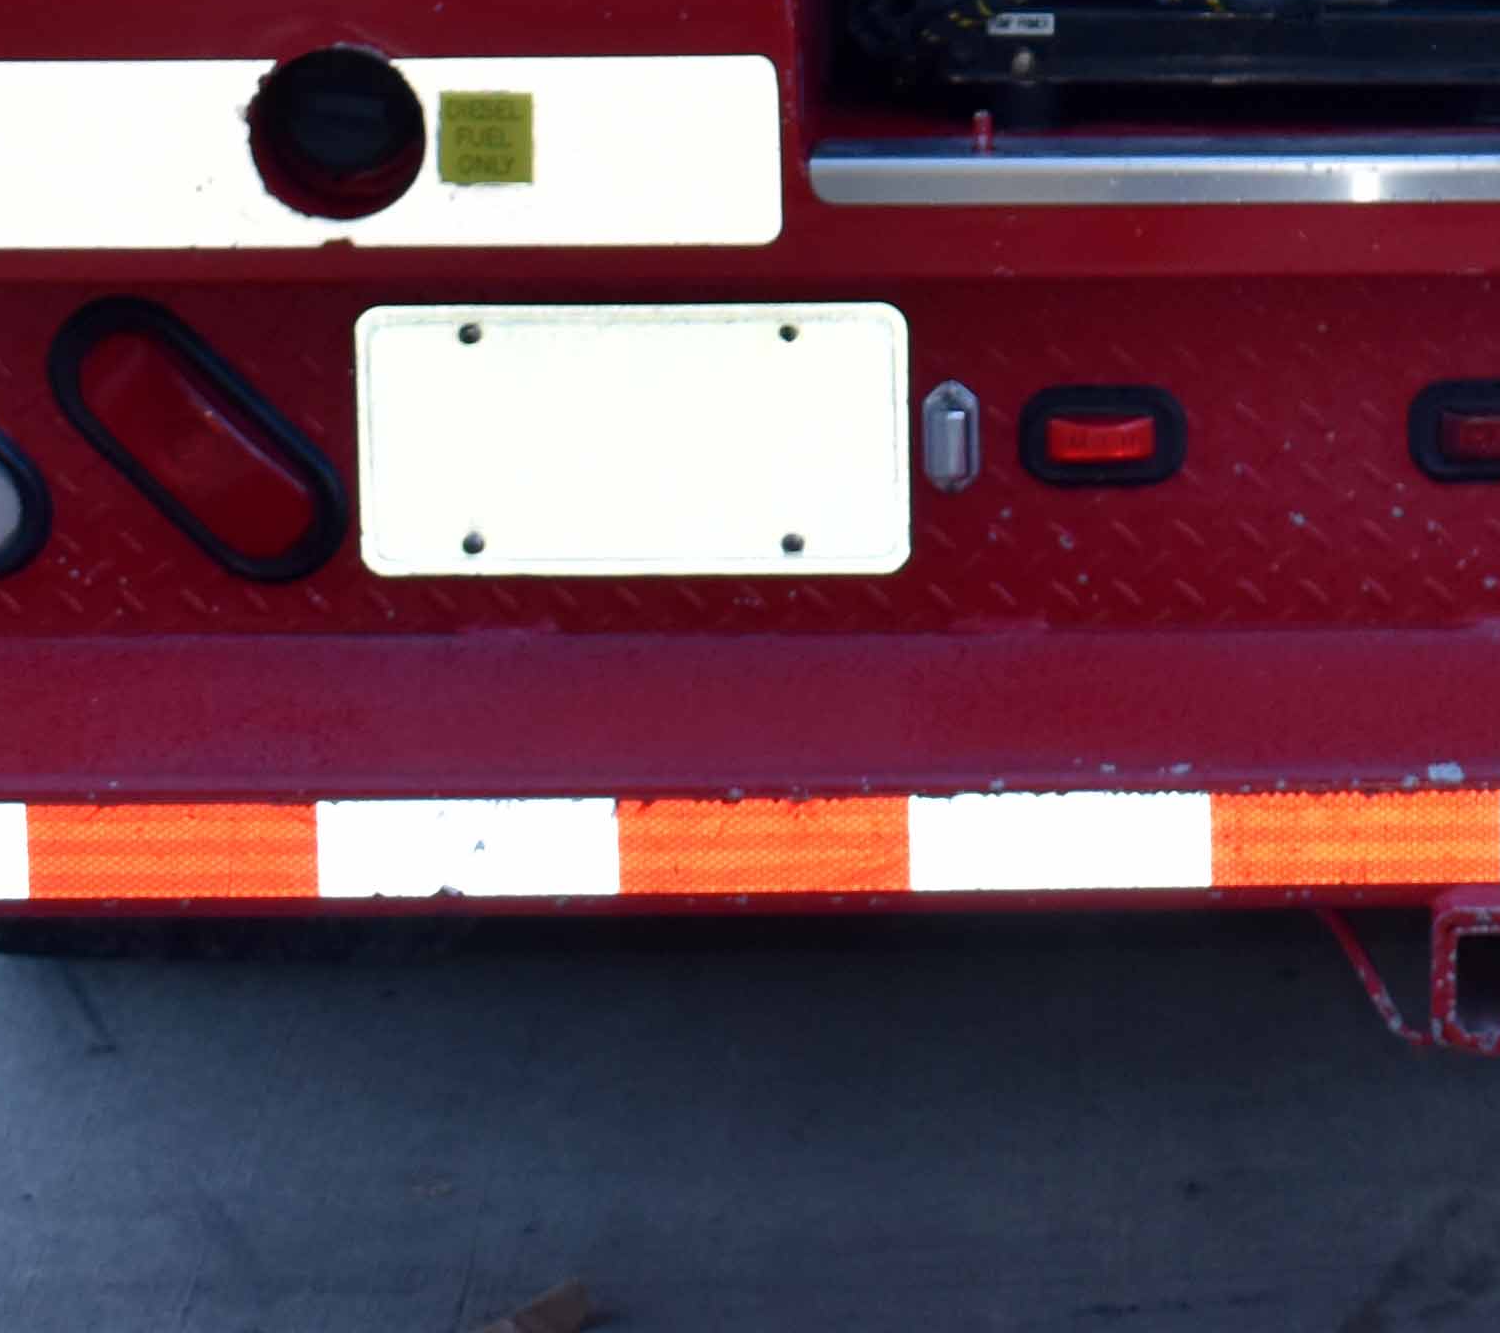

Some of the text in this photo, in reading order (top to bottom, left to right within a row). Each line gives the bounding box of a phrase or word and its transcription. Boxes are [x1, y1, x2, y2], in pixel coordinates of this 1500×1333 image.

[446, 99, 522, 121] DIESEL
[456, 126, 513, 148] FUEL
[456, 154, 515, 176] ONLY
